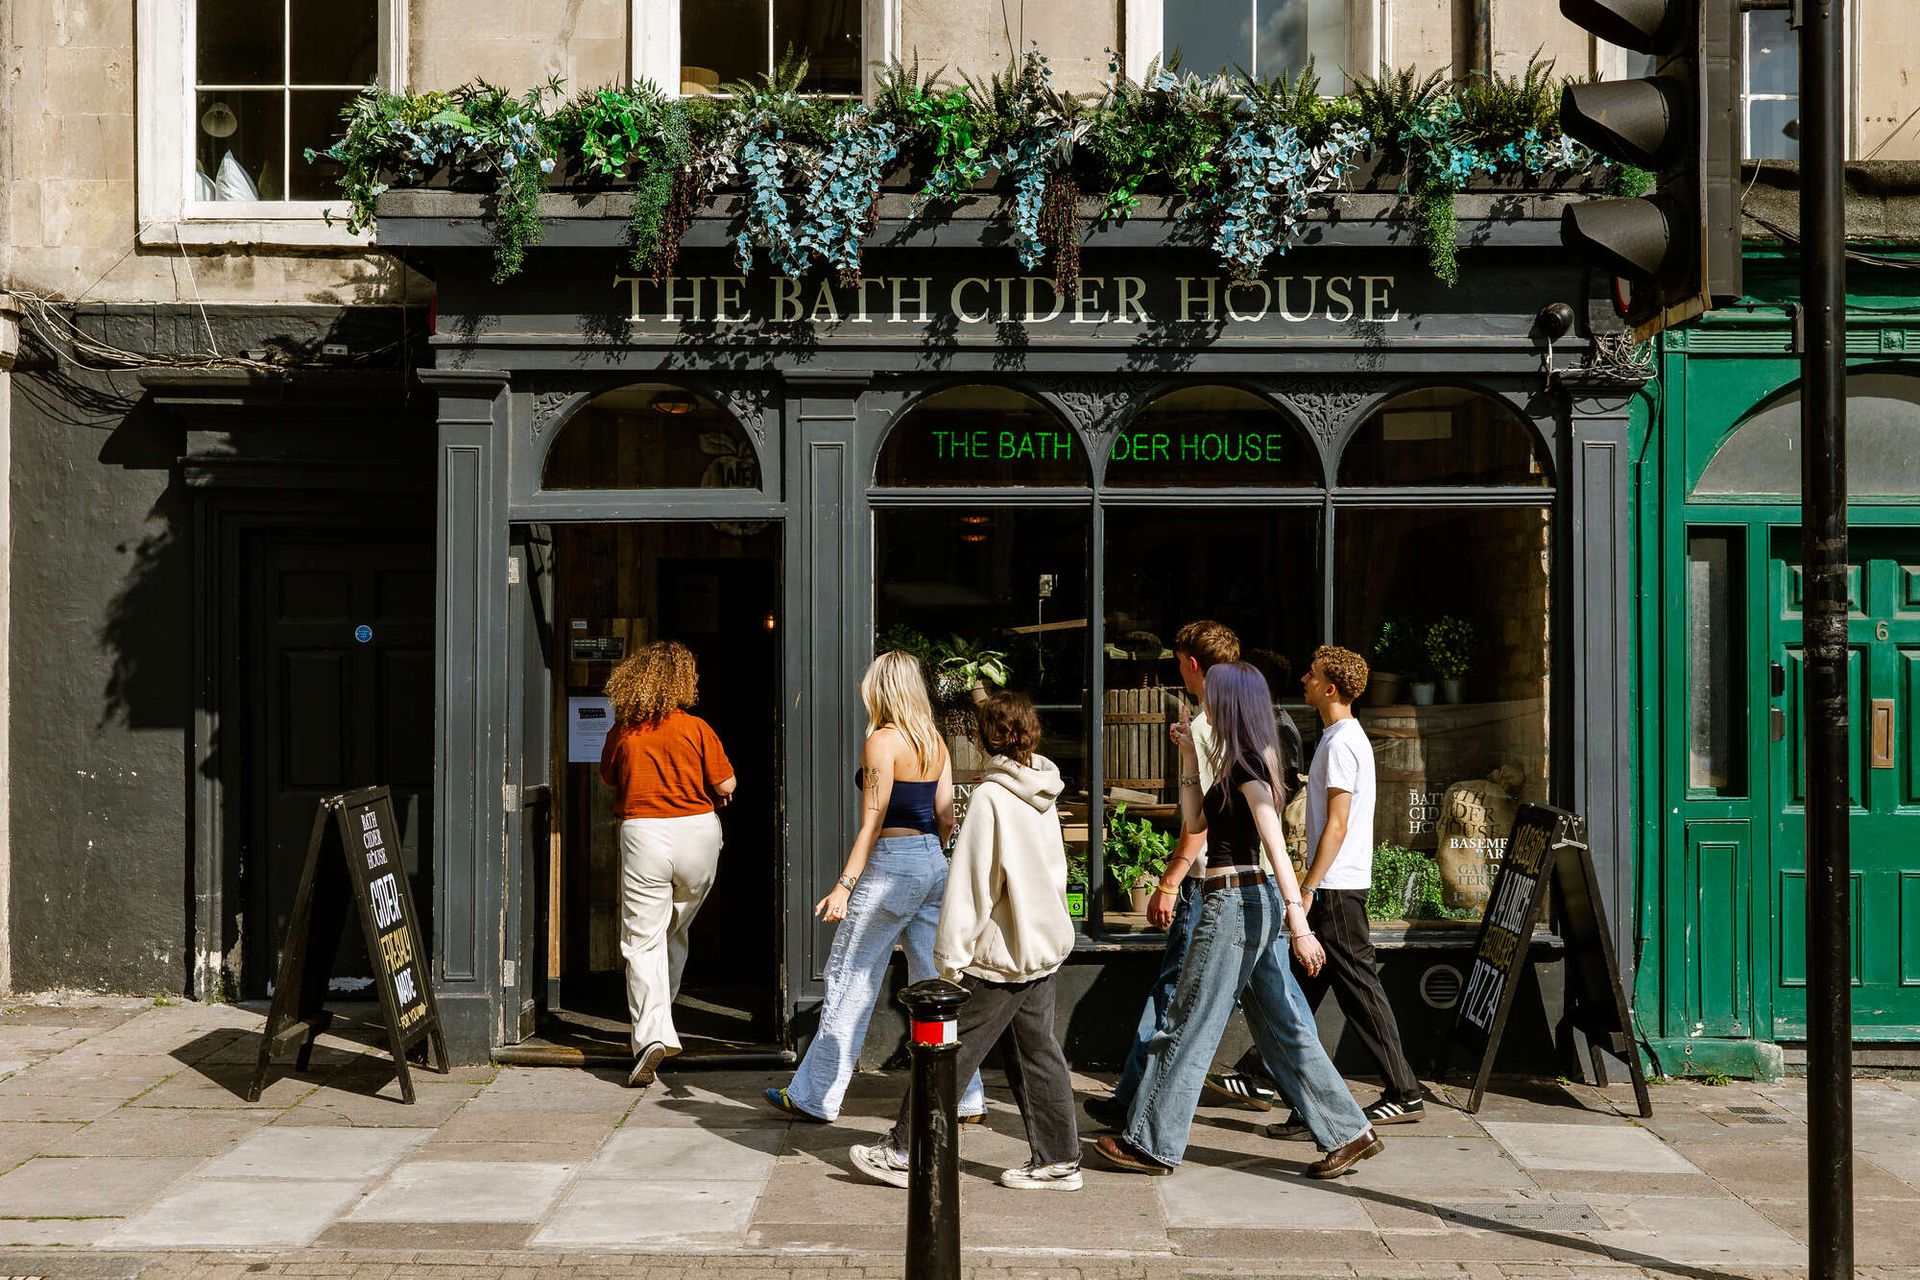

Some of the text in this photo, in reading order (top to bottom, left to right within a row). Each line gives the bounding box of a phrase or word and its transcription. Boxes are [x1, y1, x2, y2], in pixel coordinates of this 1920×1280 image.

[612, 275, 1399, 324] THE BATH CIDER HOUSE
[931, 431, 1282, 461] THE BATH DER HOUSE
[1875, 620, 1889, 641] 6
[361, 811, 378, 831] BATH
[363, 829, 383, 849] CIDER
[366, 847, 388, 869] HOUSE
[370, 873, 402, 929] CIDER
[380, 925, 413, 974] FRESHLY
[394, 967, 417, 1007] MADE
[1459, 958, 1504, 1034] PIZZA
